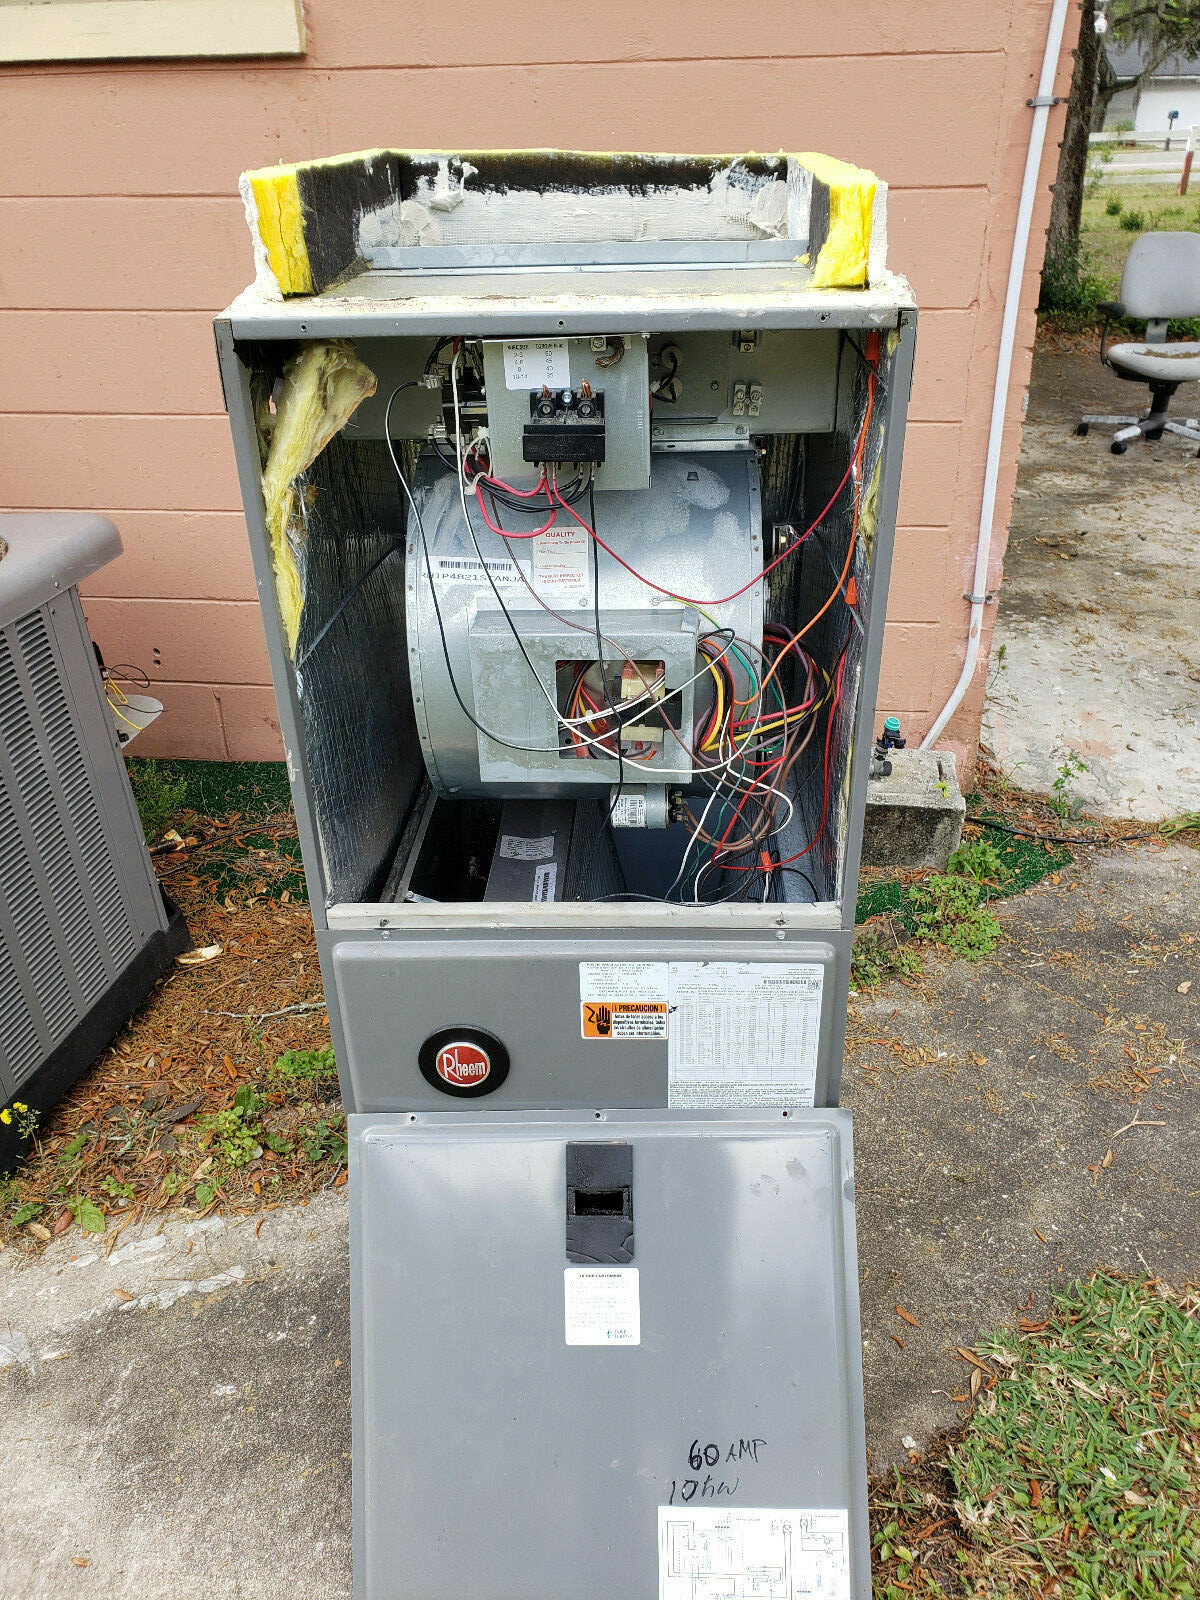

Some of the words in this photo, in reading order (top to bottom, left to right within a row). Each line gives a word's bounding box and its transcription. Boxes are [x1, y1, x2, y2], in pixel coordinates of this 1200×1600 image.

[618, 1004, 659, 1012] PRECAUCION
[442, 1048, 486, 1081] Rheem
[688, 1439, 720, 1471] 60
